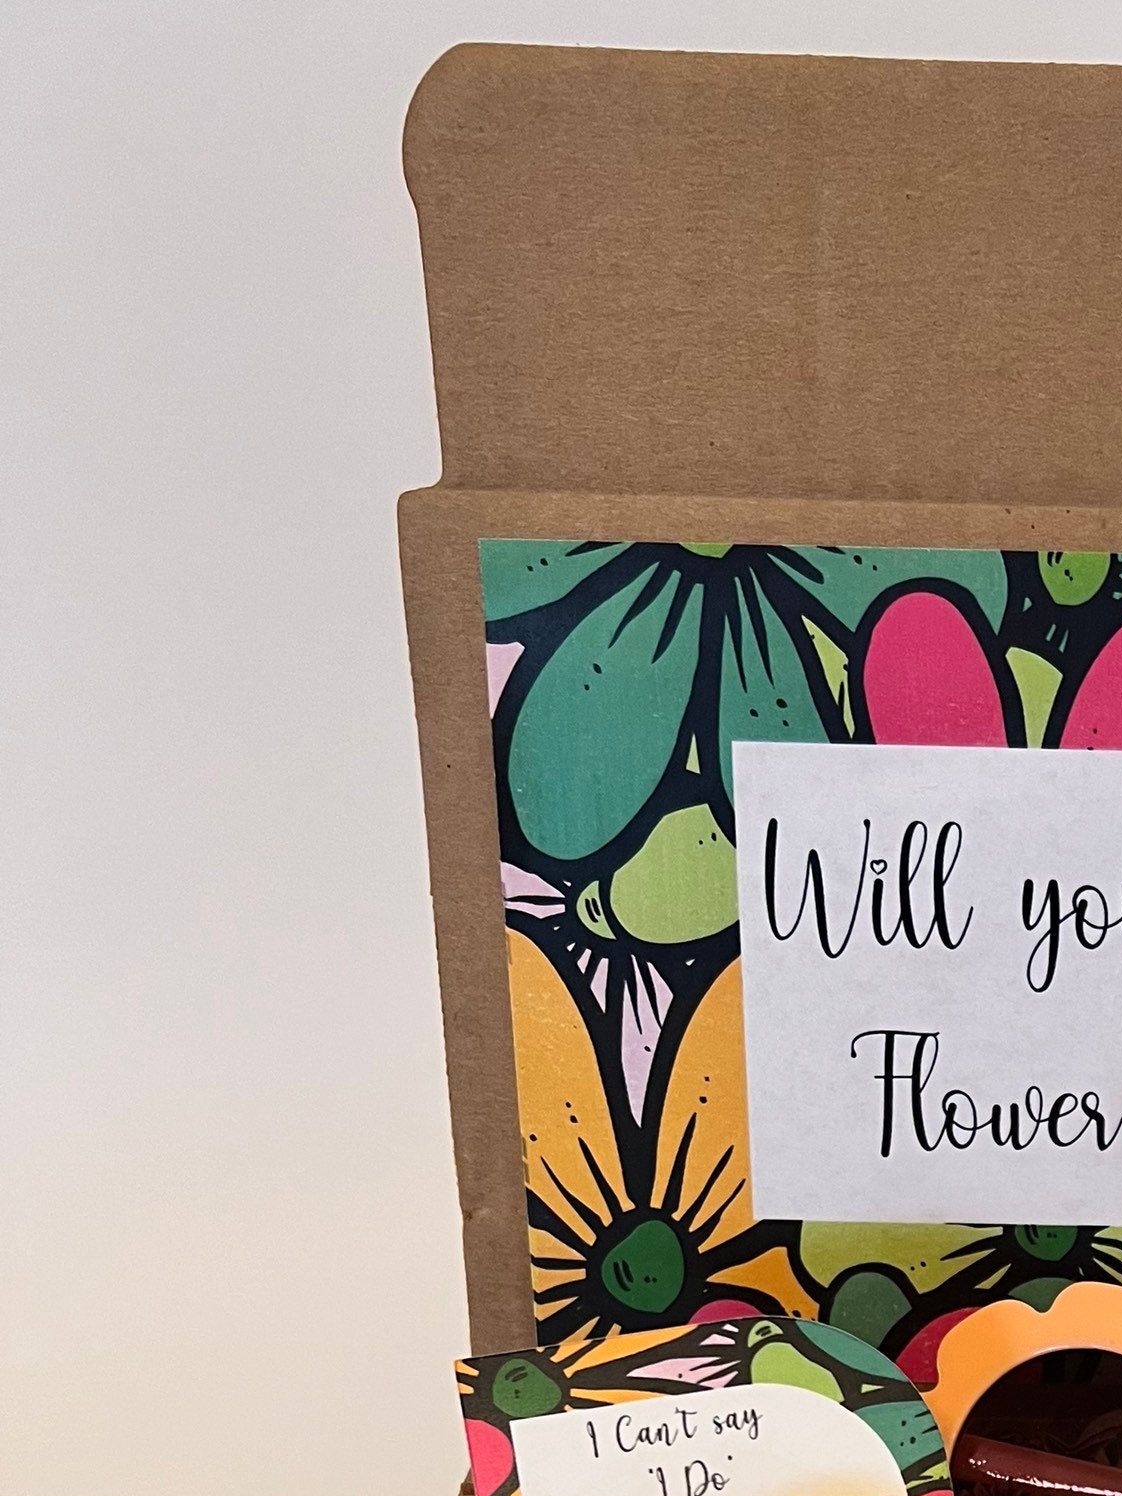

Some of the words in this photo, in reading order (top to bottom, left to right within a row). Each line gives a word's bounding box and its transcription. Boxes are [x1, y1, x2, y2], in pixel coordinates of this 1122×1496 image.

[764, 817, 974, 959] Will
[586, 1420, 600, 1458] I
[712, 1408, 763, 1440] say
